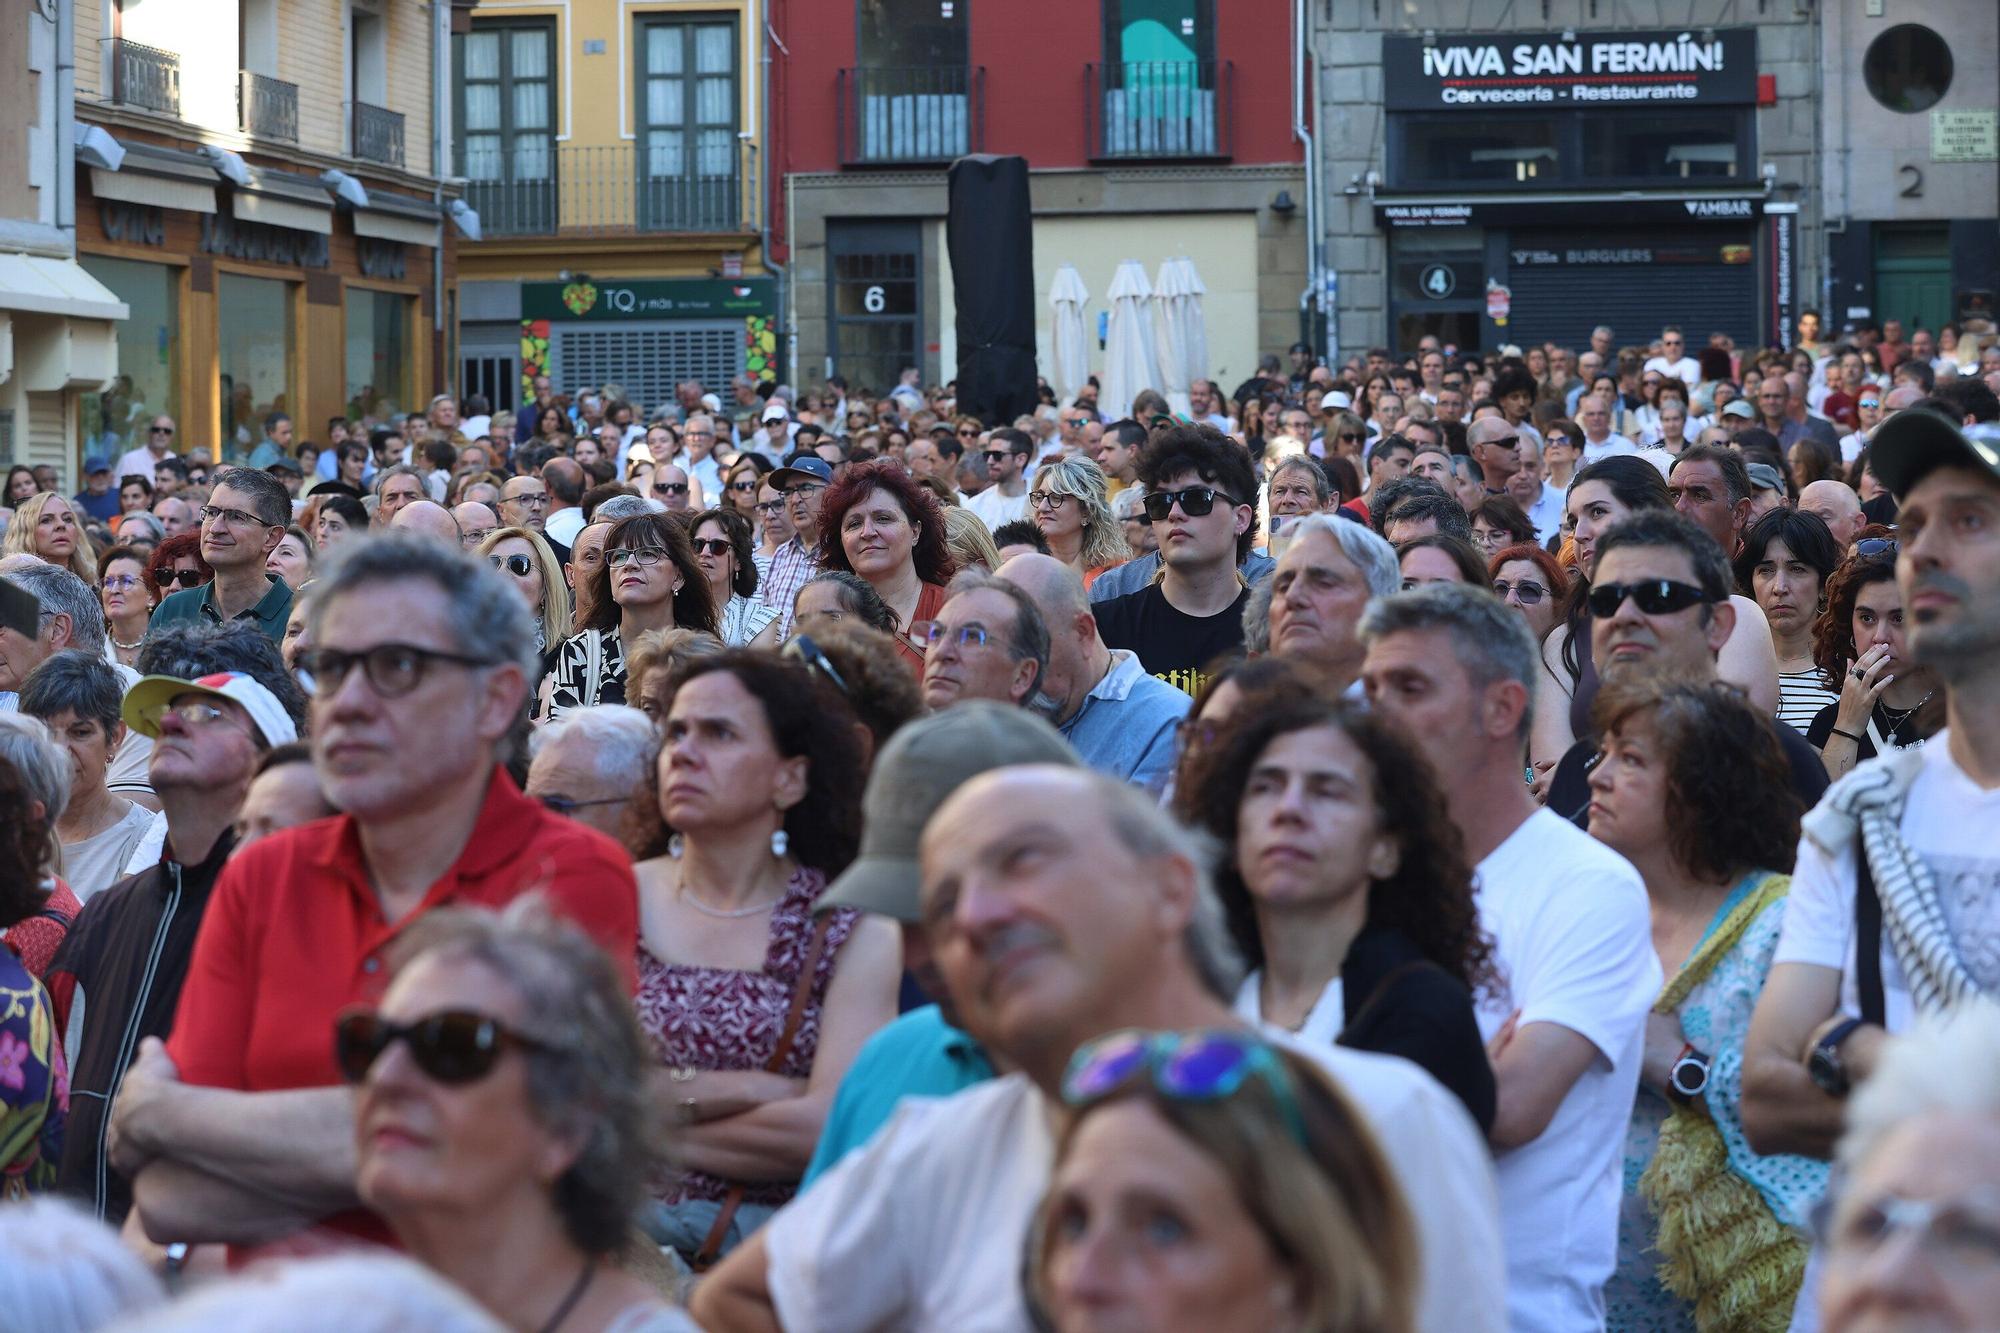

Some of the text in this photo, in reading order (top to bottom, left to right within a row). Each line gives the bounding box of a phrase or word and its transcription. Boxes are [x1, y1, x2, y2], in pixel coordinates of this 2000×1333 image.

[1424, 33, 1724, 77] ¡VIVA SAN FERMÍN!
[1441, 84, 1553, 104] Cervecería
[1572, 81, 1699, 102] Restaurante
[1899, 164, 1924, 198] 2
[1697, 200, 1753, 216] AMBAR
[1565, 248, 1653, 264] BURGUERS
[1778, 214, 1792, 305] Restaurante
[1427, 269, 1448, 294] 4
[604, 289, 636, 313] TQ
[648, 297, 674, 310] más
[864, 286, 886, 313] 6
